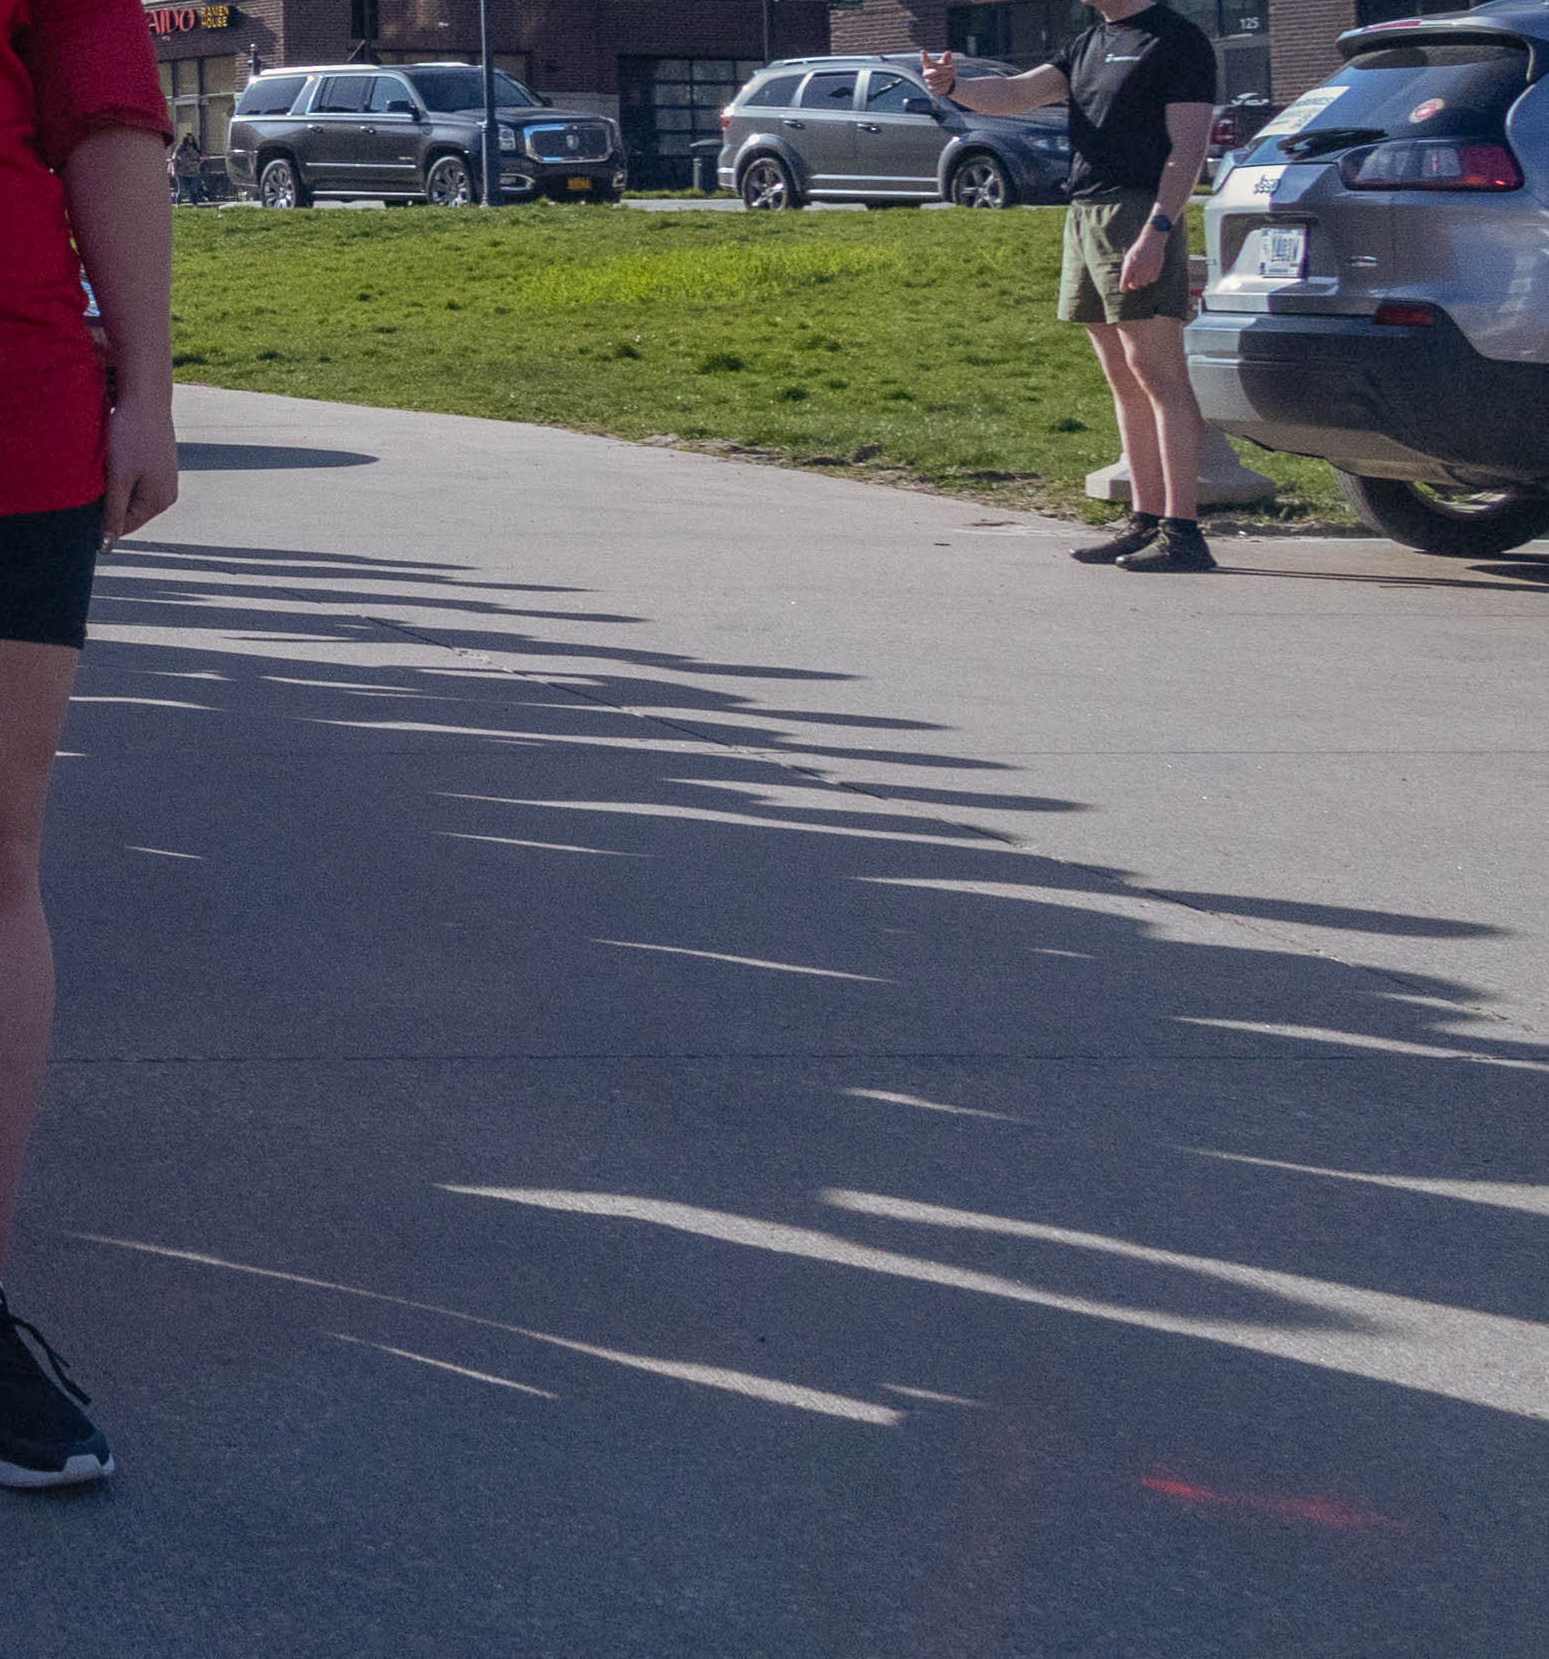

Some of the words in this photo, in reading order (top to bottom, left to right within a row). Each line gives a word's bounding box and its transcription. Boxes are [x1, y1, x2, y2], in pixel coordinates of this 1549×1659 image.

[201, 5, 229, 16] RAMEN
[149, 8, 195, 35] AIDO
[201, 17, 228, 28] HOUSE
[1239, 16, 1260, 30] 125
